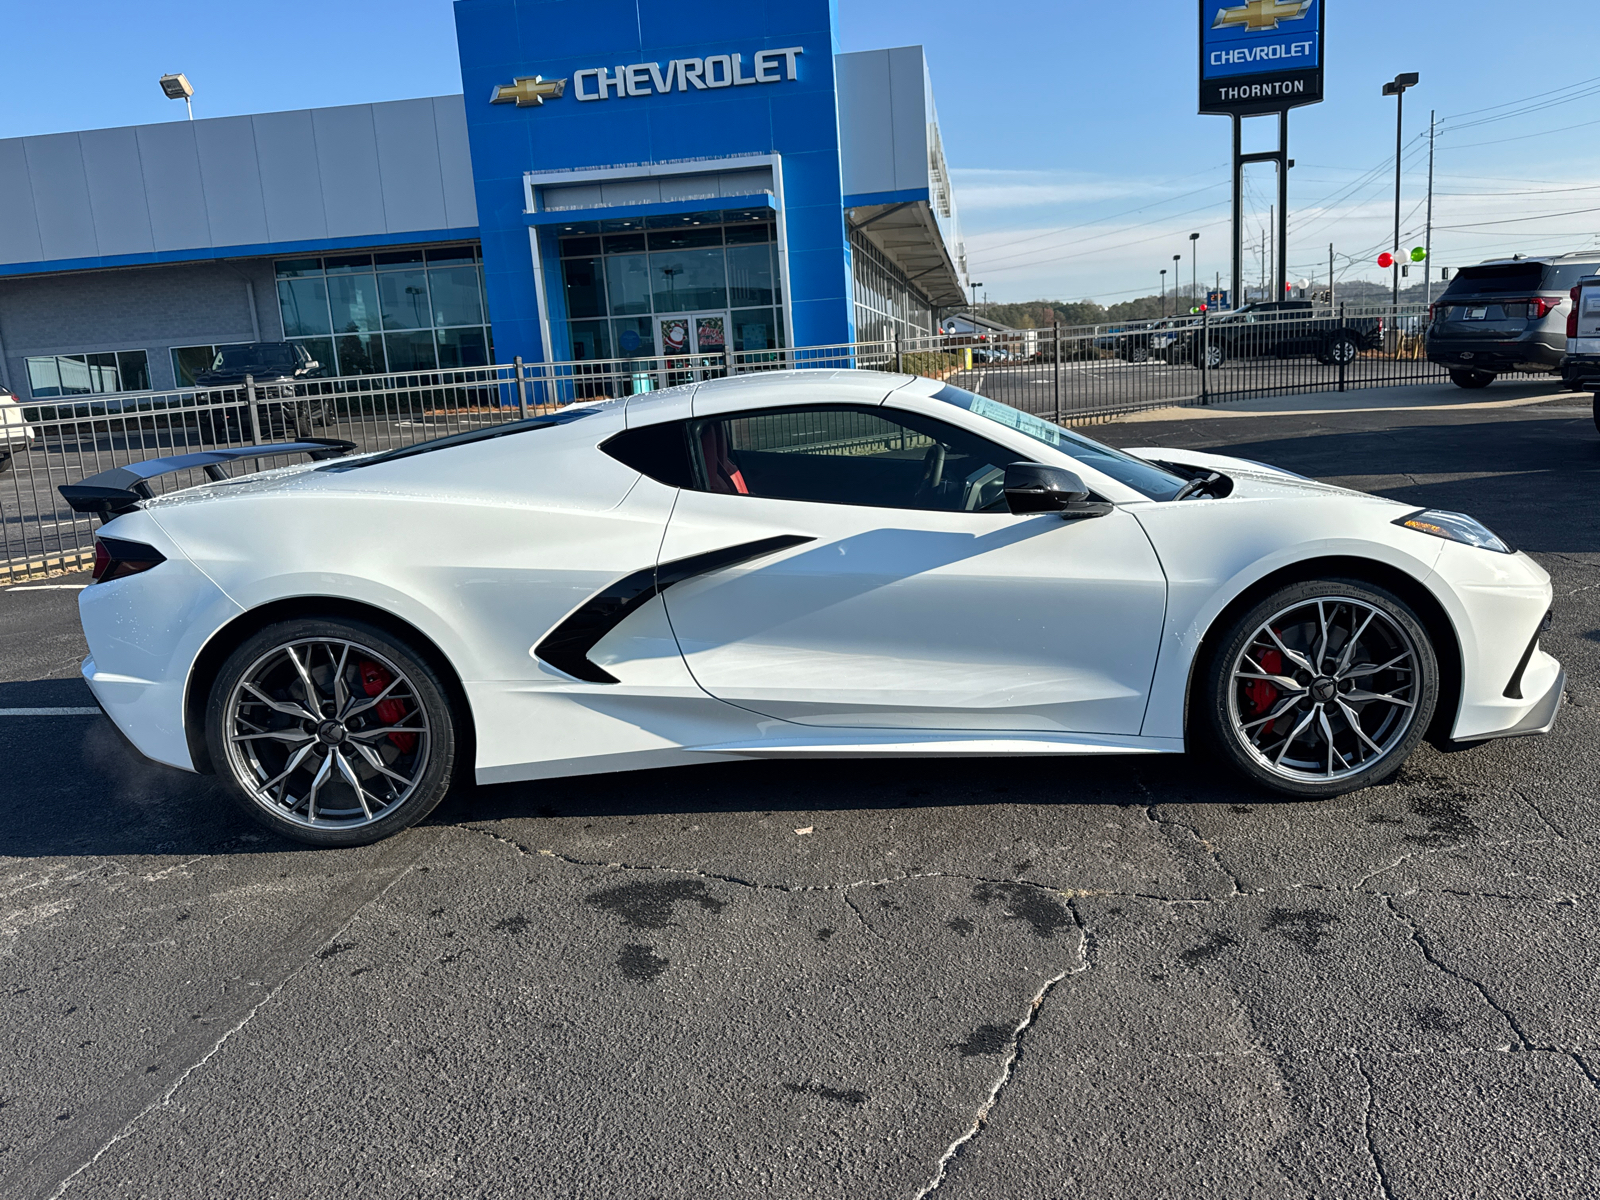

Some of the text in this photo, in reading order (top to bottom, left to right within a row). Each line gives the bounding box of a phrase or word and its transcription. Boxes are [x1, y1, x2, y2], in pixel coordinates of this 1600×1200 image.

[1210, 41, 1313, 66] CHEVROLET
[573, 46, 804, 102] CHEVROLET
[1218, 79, 1304, 100] THORNTON
